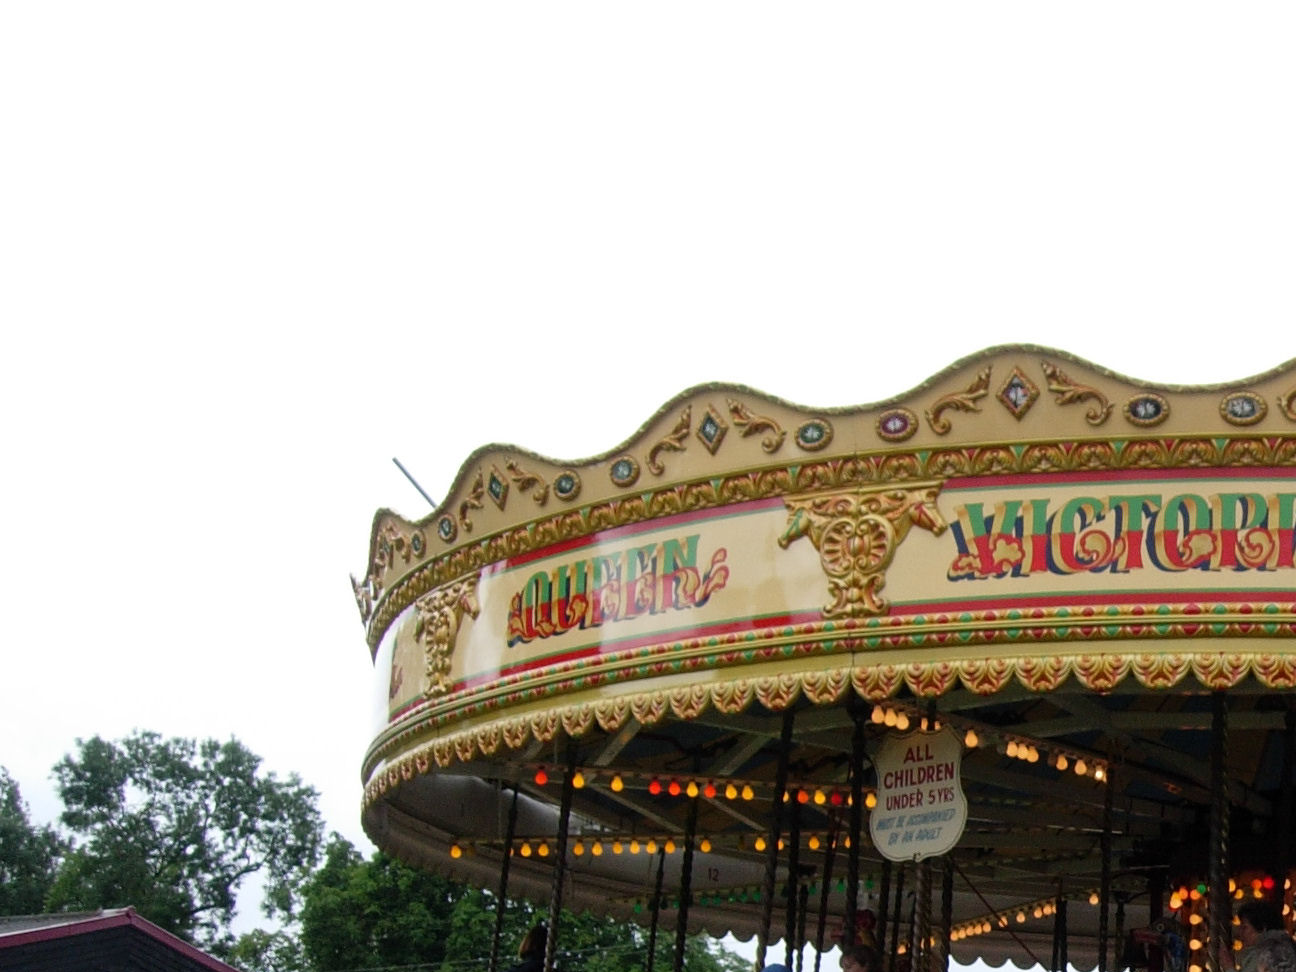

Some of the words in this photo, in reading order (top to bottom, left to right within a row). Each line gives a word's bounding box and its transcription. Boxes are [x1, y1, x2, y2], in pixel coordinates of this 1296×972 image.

[507, 534, 729, 648] QUEEN
[904, 744, 934, 764] ALL
[884, 762, 955, 789] CHILDREN
[886, 789, 924, 811] UNDER
